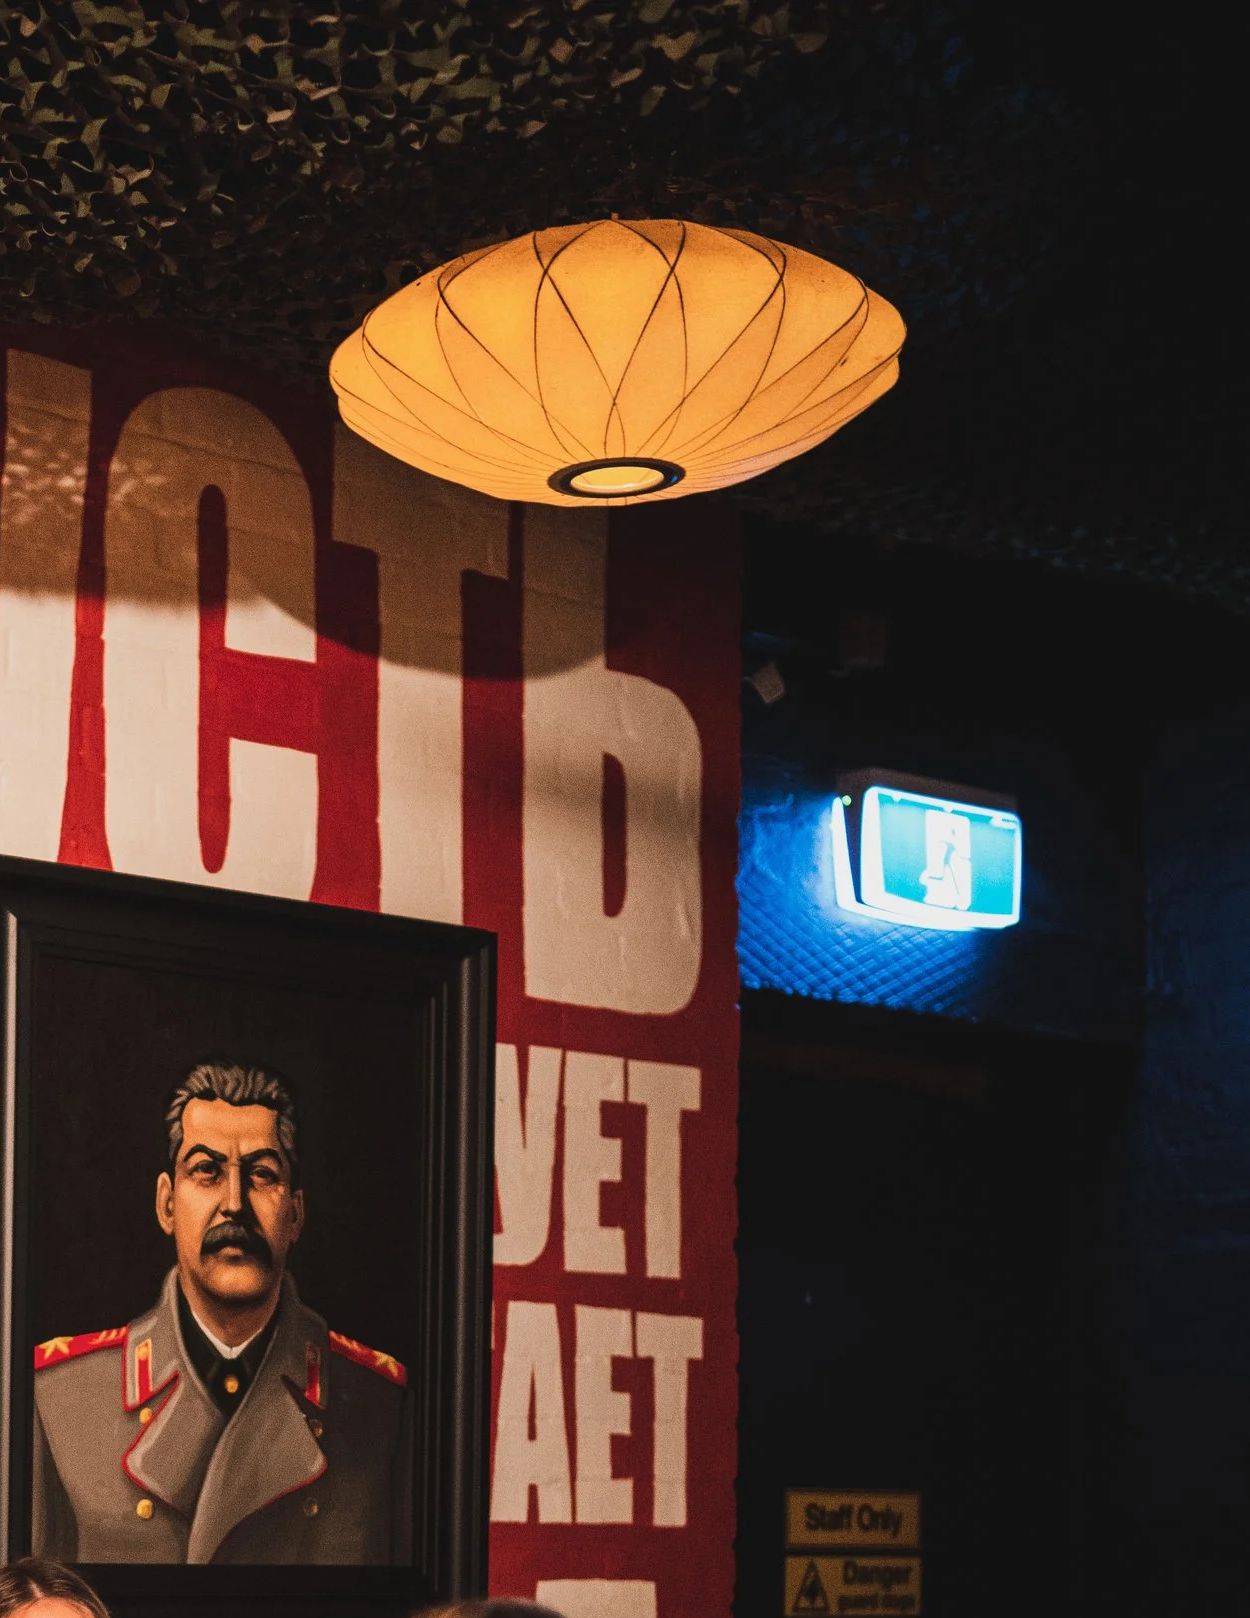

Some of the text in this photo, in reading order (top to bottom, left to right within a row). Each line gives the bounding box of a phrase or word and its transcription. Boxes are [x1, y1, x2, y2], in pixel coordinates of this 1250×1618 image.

[805, 1503, 902, 1538] Staff Only
[843, 1560, 911, 1590] Danger
